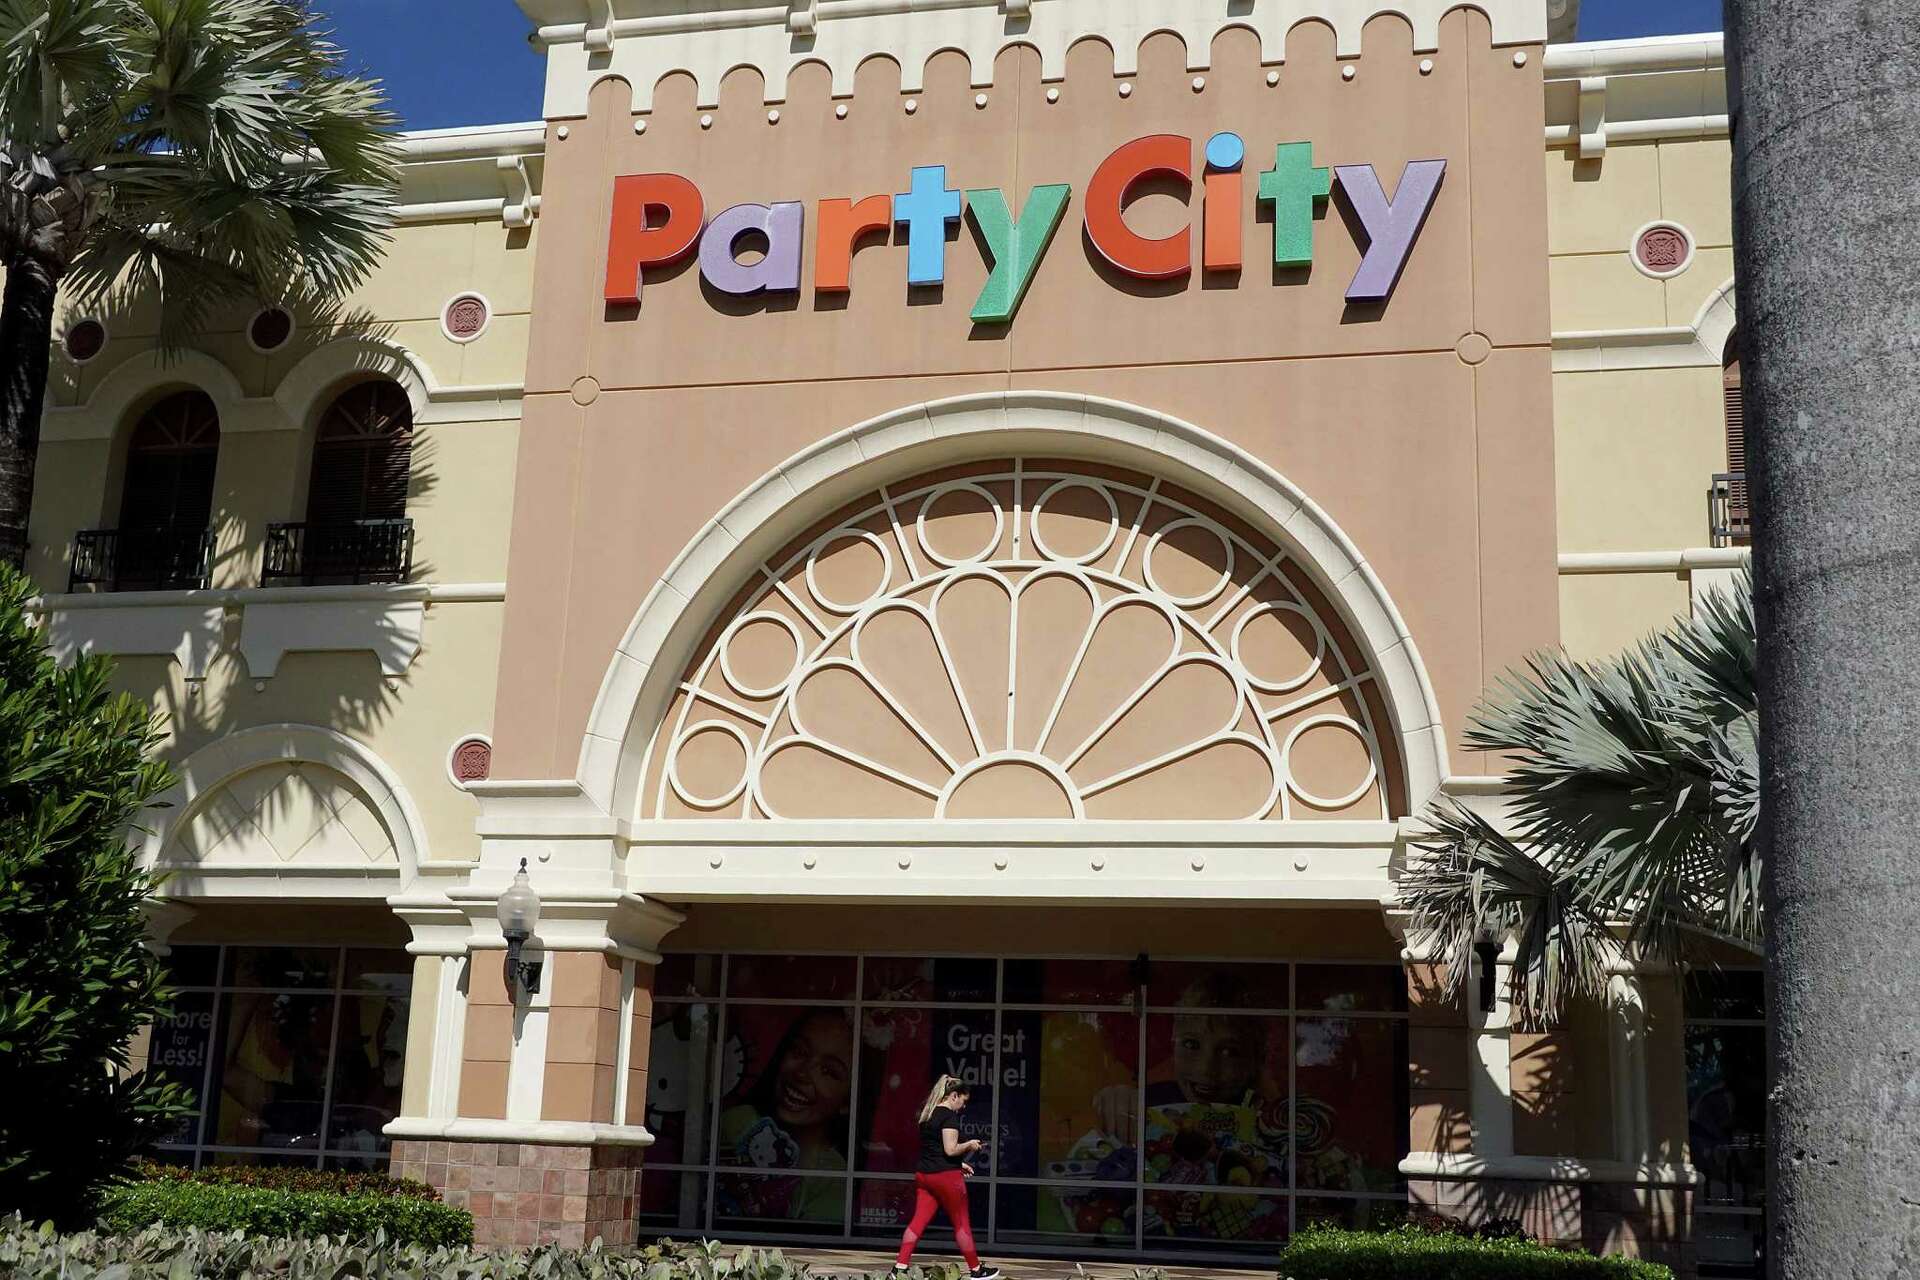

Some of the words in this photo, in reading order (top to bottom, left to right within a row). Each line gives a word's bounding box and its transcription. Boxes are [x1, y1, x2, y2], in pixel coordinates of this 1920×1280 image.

[604, 165, 1071, 323] Party
[1082, 131, 1447, 304] City
[172, 1029, 191, 1046] for
[946, 1024, 1027, 1053] Great
[152, 1040, 204, 1067] Less!
[959, 1114, 1009, 1136] favos
